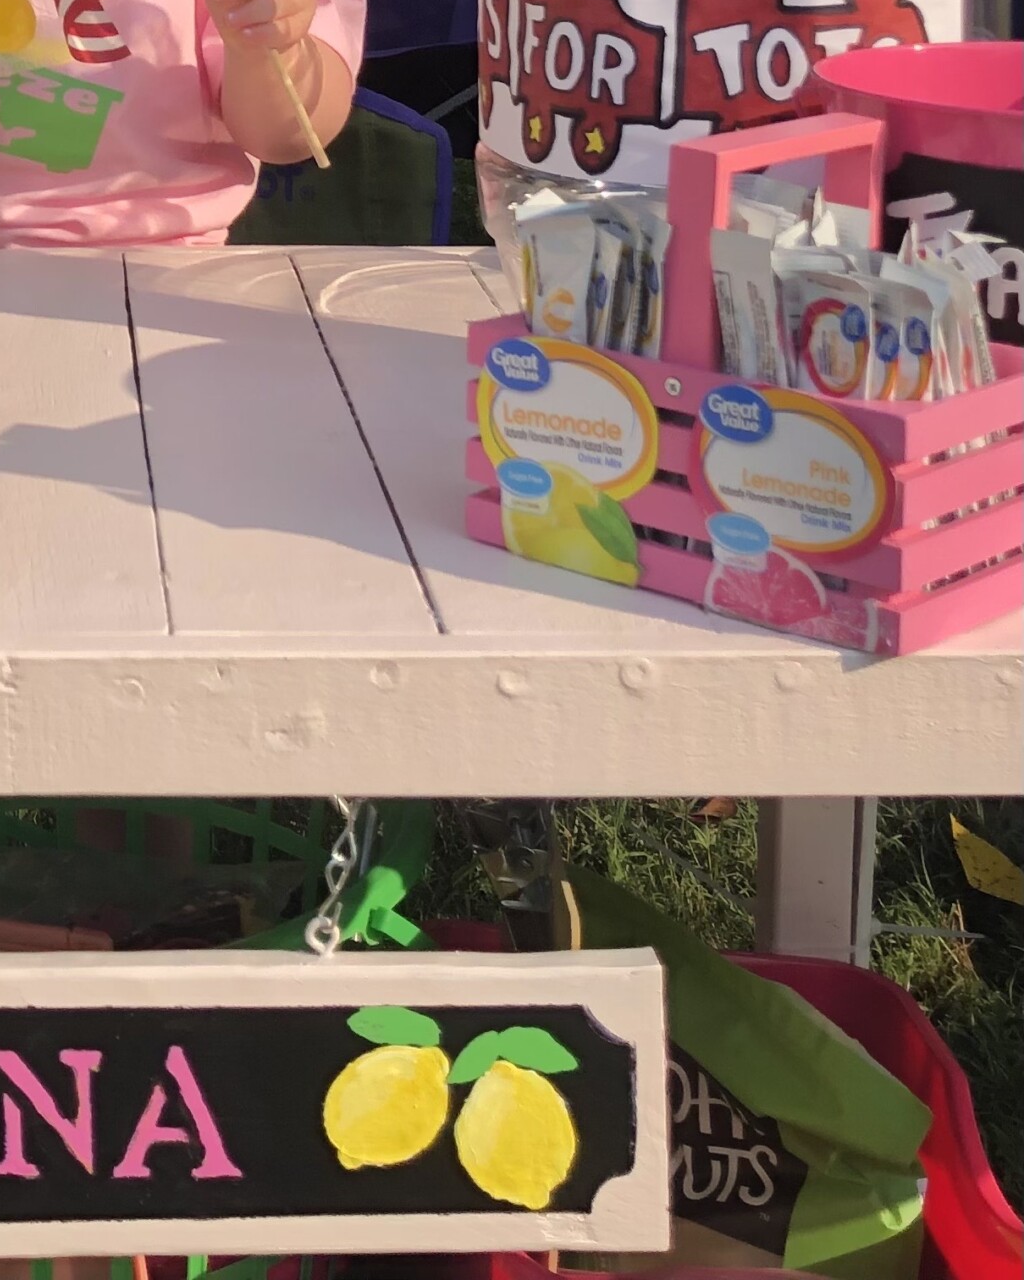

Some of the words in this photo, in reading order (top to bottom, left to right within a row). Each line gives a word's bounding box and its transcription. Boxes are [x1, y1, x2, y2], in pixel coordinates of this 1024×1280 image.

[523, 1, 636, 106] FOR
[491, 347, 539, 369] Great
[707, 393, 760, 420] Great
[503, 400, 622, 442] Lemonade
[720, 414, 761, 433] Value
[809, 459, 850, 485] Pink
[742, 467, 851, 507] Lemonade
